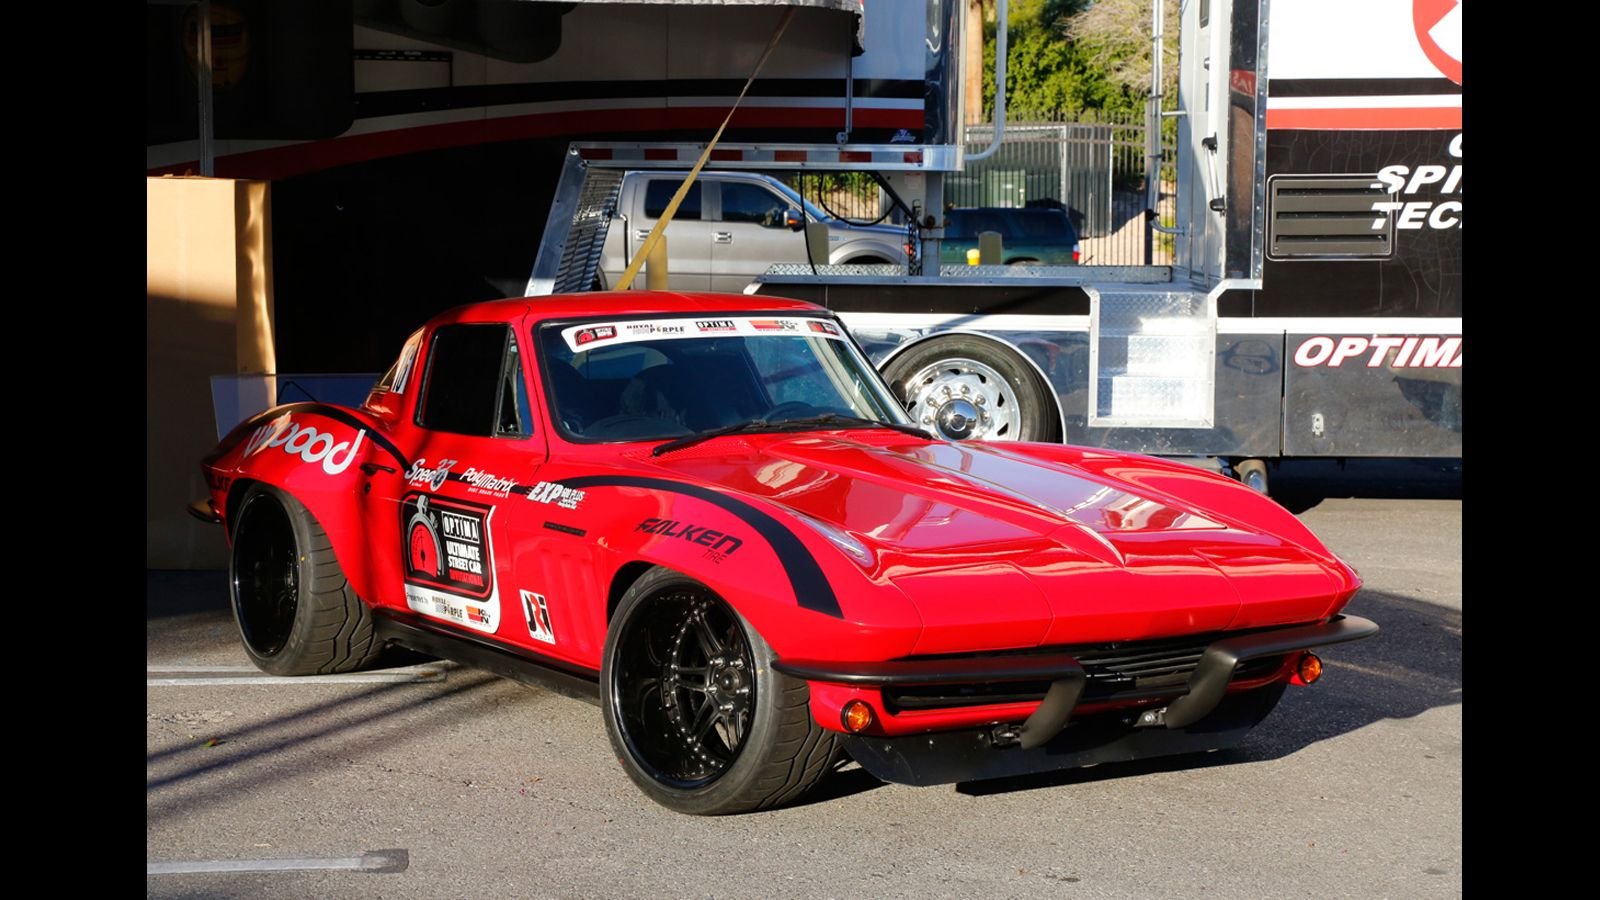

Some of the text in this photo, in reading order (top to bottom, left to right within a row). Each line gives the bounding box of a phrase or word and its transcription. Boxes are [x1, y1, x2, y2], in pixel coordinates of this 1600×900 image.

[1370, 165, 1462, 194] SPI
[1371, 201, 1462, 229] TEC
[527, 481, 564, 504] EXP
[443, 515, 480, 540] OPTIMA
[633, 518, 743, 555] FALKEN
[446, 541, 480, 562] ULTIMATE
[702, 549, 728, 564] TIRE
[448, 555, 482, 575] STREET CAR
